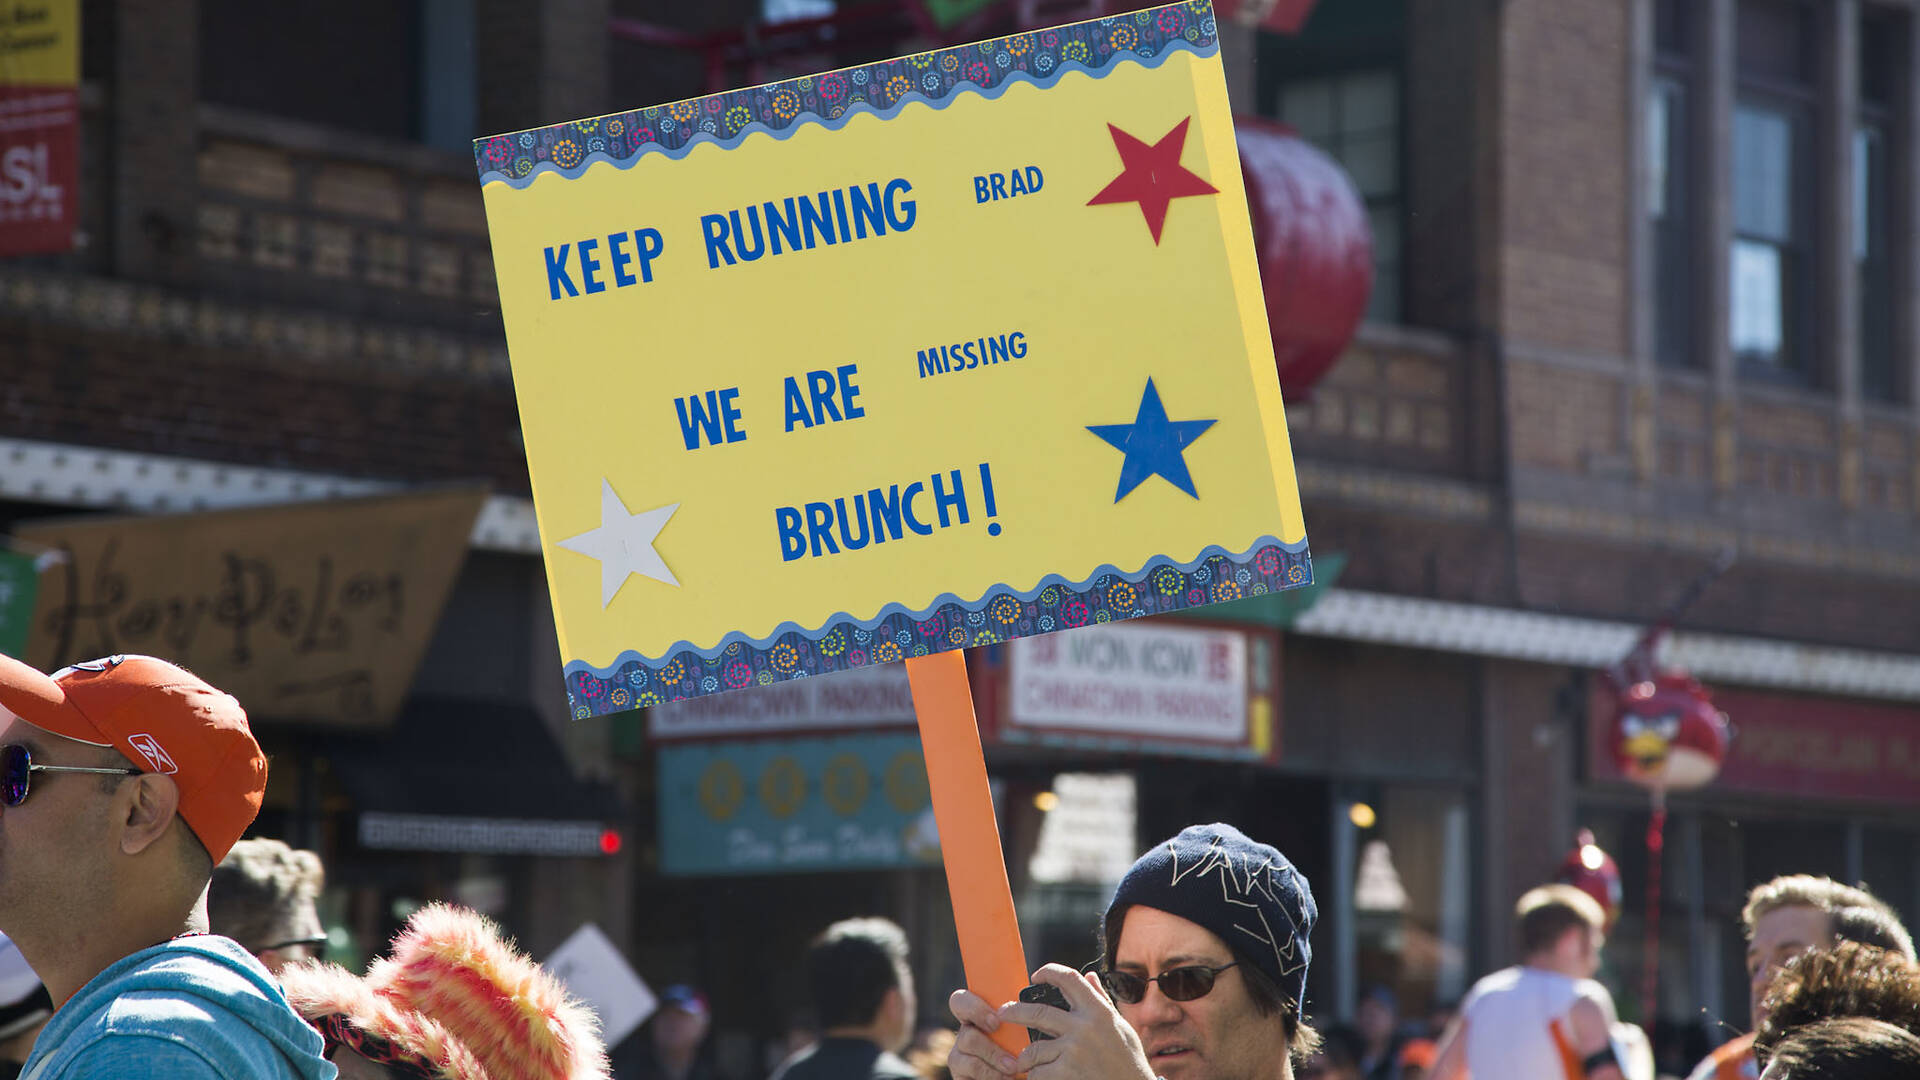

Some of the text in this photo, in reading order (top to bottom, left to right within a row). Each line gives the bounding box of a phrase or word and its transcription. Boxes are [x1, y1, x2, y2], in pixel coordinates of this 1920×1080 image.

[545, 166, 1044, 300] KEEP RUNNING BRAD
[674, 331, 1028, 450] WE ARE MISSING
[775, 463, 1002, 562] BRUNCH!
